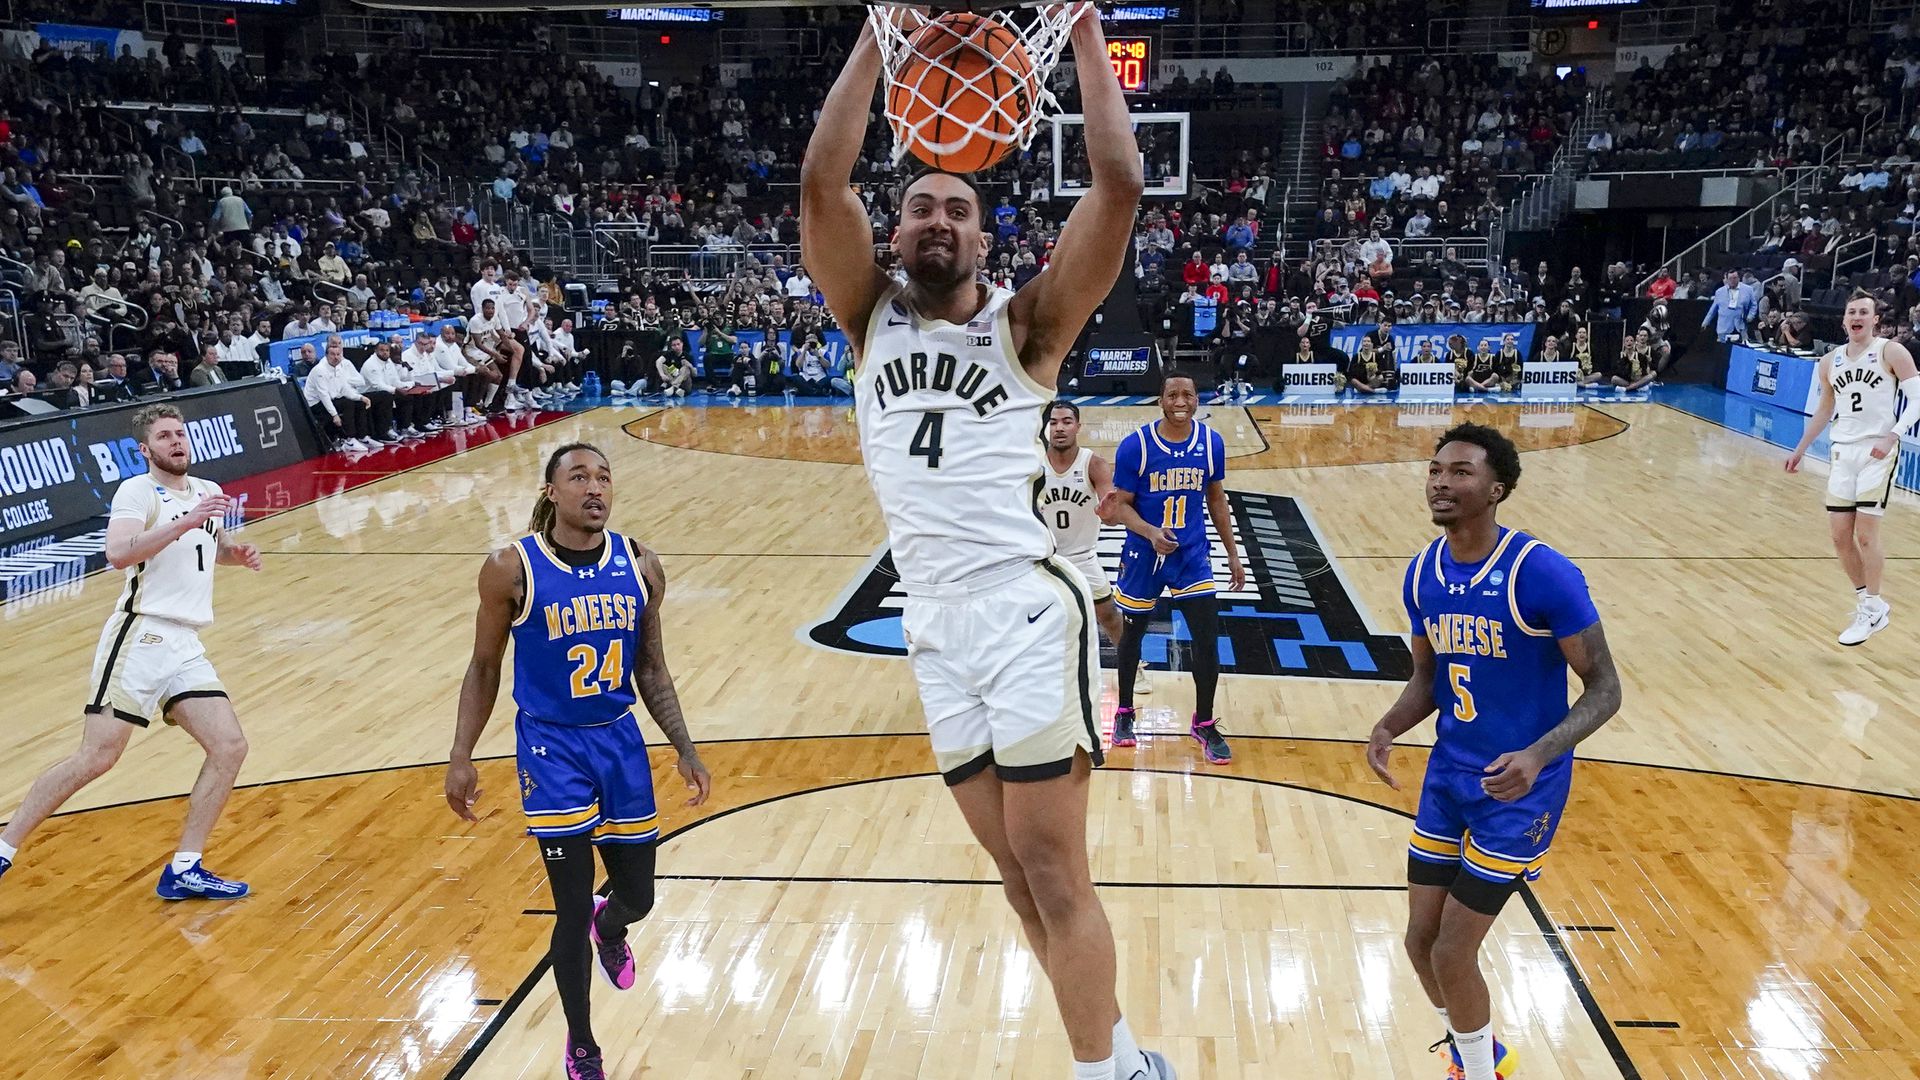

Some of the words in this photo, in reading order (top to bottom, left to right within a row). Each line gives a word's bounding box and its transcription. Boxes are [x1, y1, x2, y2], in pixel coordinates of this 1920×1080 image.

[620, 8, 710, 21] MARCHMADNESS
[620, 67, 637, 77] 127
[1315, 61, 1333, 71] 102
[1100, 351, 1133, 361] MARCH
[1331, 335, 1467, 362] MNES
[1103, 361, 1148, 371] MADNESS
[1402, 372, 1454, 385] BOILERS
[1524, 371, 1577, 384] BOILERS
[875, 352, 1009, 417] PURDUE
[1285, 373, 1334, 386] BOILERS
[1833, 368, 1883, 393] PURDUE
[1851, 392, 1863, 412] 2
[183, 414, 243, 465] RDUE
[254, 406, 283, 449] P
[909, 412, 945, 469] 4
[1149, 467, 1206, 493] McNEESE
[1044, 486, 1092, 507] URDUE
[3, 499, 52, 530] COLLEGE
[1056, 510, 1070, 529] 0
[1161, 496, 1187, 529] 11
[195, 544, 205, 571] 1
[544, 593, 637, 641] McNEESE
[567, 639, 625, 699] 24
[1448, 662, 1479, 723] 5
